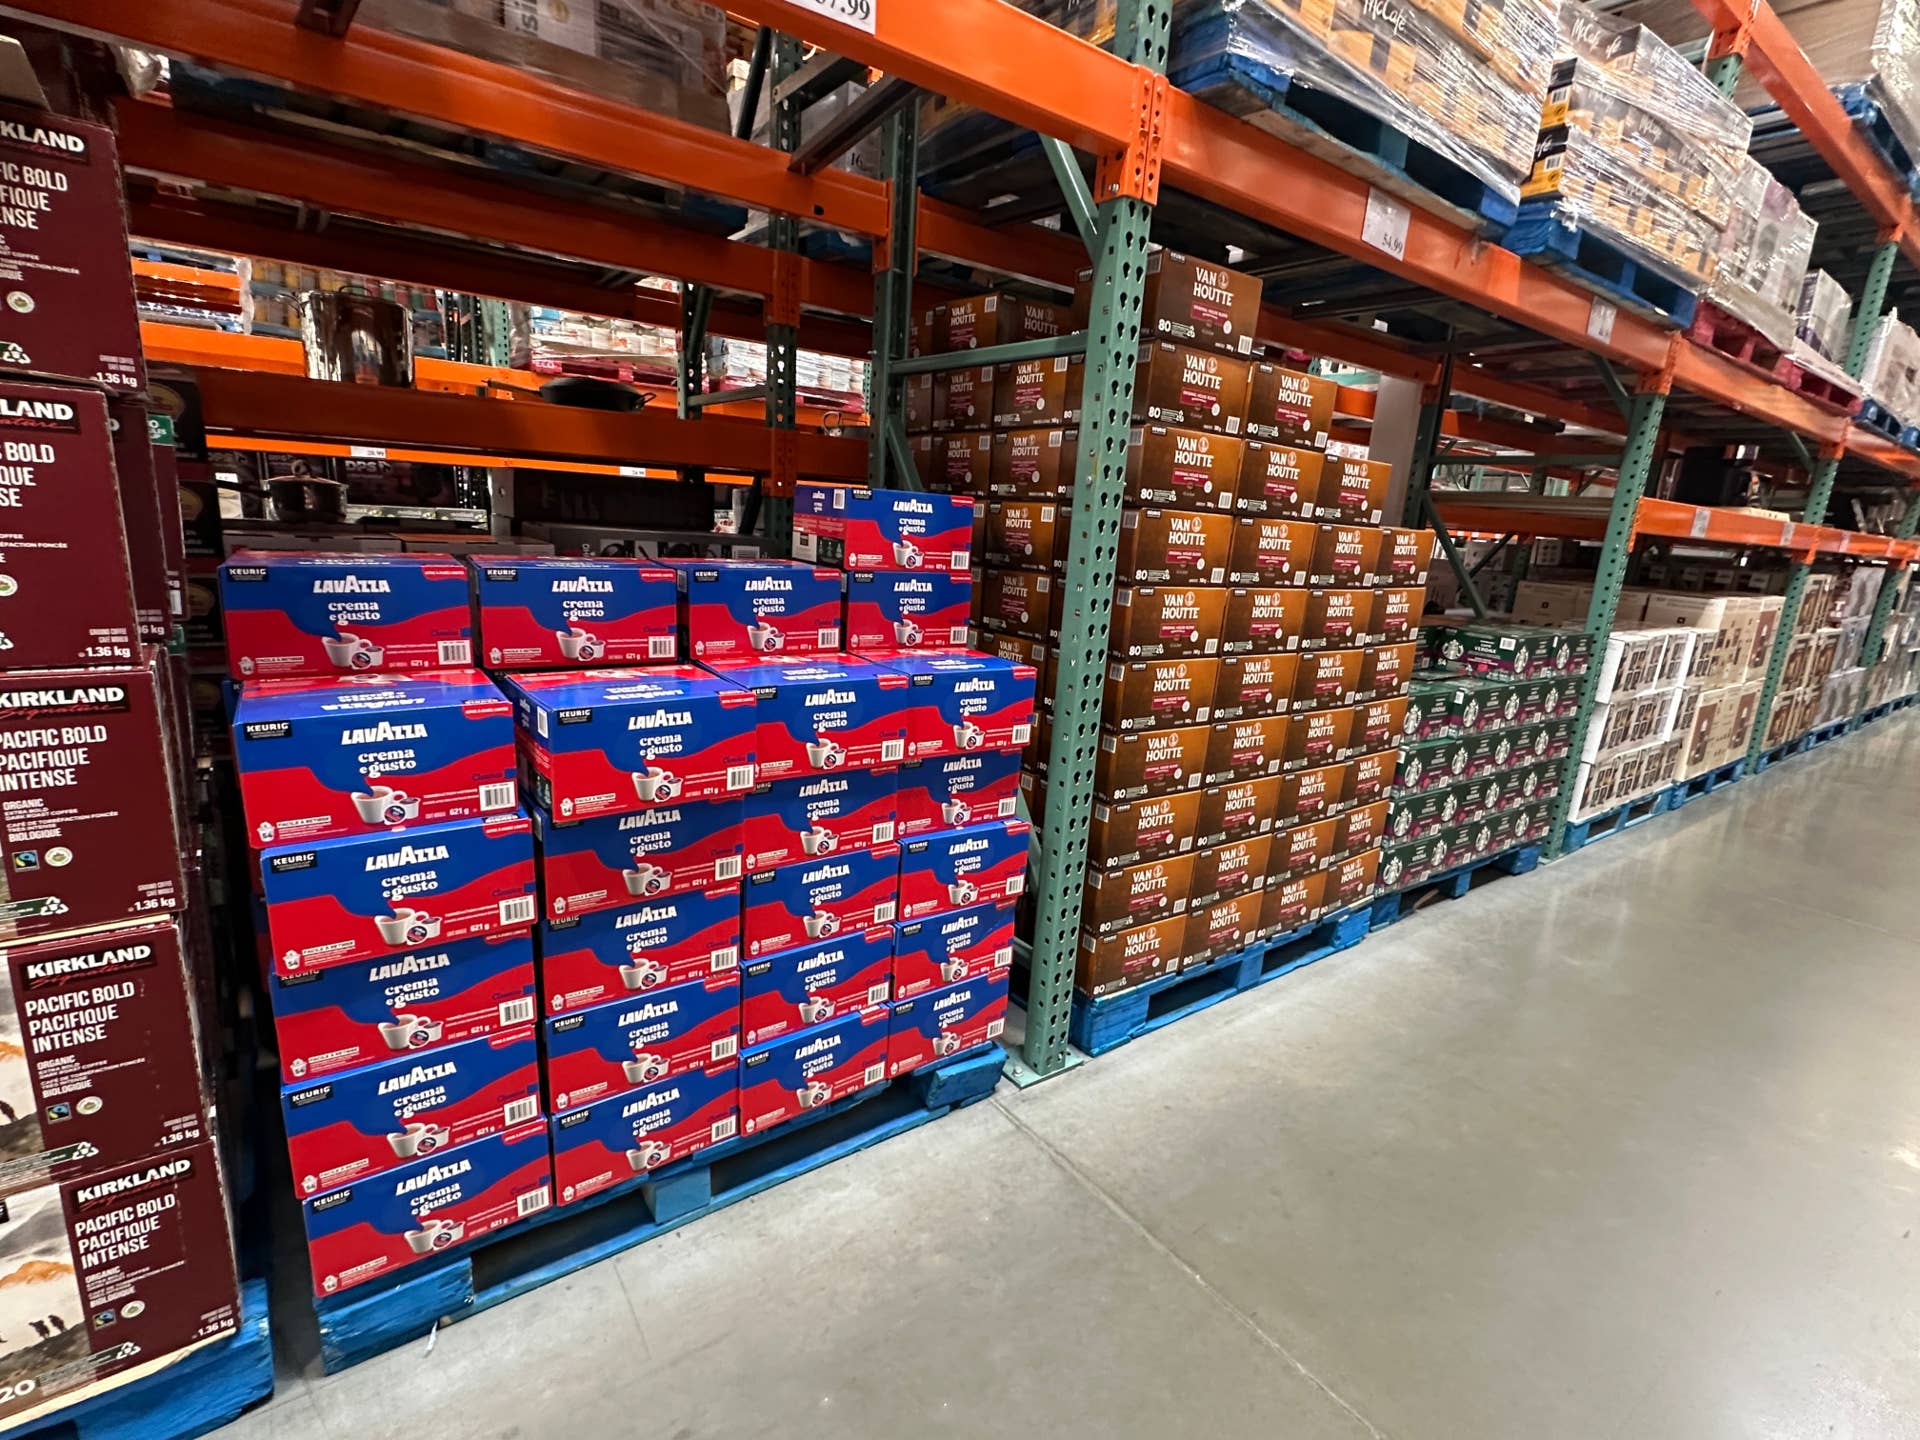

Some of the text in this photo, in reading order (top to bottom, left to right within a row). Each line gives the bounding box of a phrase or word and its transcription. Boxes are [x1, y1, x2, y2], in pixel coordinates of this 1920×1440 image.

[0, 161, 68, 191] IC BOLD
[0, 206, 39, 229] NSE
[1195, 267, 1217, 286] VAN
[1193, 282, 1234, 306] HOUTTE
[950, 313, 976, 326] HOUTTE
[951, 305, 966, 317] VAN
[1158, 319, 1171, 332] 80
[1017, 364, 1031, 375] VAN
[1185, 354, 1206, 371] VAN
[122, 374, 138, 387] kg
[1016, 372, 1045, 386] HOUTTE
[1182, 368, 1222, 390] HOUTTE
[1281, 375, 1300, 390] VAN
[1278, 389, 1313, 408] HOUTTE
[1, 399, 74, 421] LAND
[1149, 406, 1161, 418] 80
[1247, 423, 1259, 434] 80
[4, 441, 55, 463] BOLD
[1176, 436, 1198, 452] VAN
[1174, 450, 1214, 468] HOUTTE
[1140, 488, 1153, 500] 80
[893, 499, 933, 514] LAVAZZA
[899, 517, 926, 526] crema
[903, 524, 926, 535] gusto
[1170, 518, 1191, 532] VAN
[1168, 532, 1207, 546] HOUTTE
[229, 568, 266, 576] KEURIG
[1135, 569, 1148, 580] 80
[313, 575, 391, 593] LAVAZZA
[552, 576, 614, 592] LAVAZZA
[745, 576, 793, 591] LAVAZZA
[893, 578, 932, 592] LAVAZZA
[328, 602, 379, 611] crema
[563, 600, 604, 608] crema
[753, 597, 785, 605] crema
[1164, 593, 1184, 607] VAN
[338, 611, 381, 625] gusto
[570, 608, 604, 621] gusto
[758, 603, 785, 616] gusto
[1161, 606, 1200, 620] HOUTTE
[85, 646, 131, 658] 1.36 kg
[1155, 666, 1177, 679] VAN
[954, 677, 995, 693] LAVAZZA
[1153, 678, 1192, 692] HOUTTE
[0, 687, 124, 708] KIRKLAND
[804, 688, 857, 706] LAVAZZA
[960, 697, 987, 706] crema
[559, 709, 591, 718] KEURIG
[813, 710, 848, 720] crema
[963, 704, 987, 715] gusto
[246, 722, 289, 733] KEURIG
[628, 709, 693, 730] LAVAZZA
[818, 718, 848, 732] gusto
[61, 725, 108, 745] BOLD
[341, 721, 428, 745] LAVAZZA
[639, 733, 682, 747] crema
[0, 748, 90, 771] PACIFIQUE
[358, 748, 415, 764] crema
[646, 744, 683, 760] gusto
[369, 759, 417, 779] gusto
[943, 757, 982, 773] LAVAZZA
[0, 768, 78, 792] INTENSE
[799, 779, 849, 797] LAVAZZA
[2, 798, 44, 811] ORGANIC
[618, 808, 681, 831] LAVAZZA
[8, 828, 62, 842] BIOLOGIQUE
[629, 831, 671, 846] crema
[636, 839, 672, 857] gusto
[949, 838, 989, 855] LAVAZZA
[273, 853, 314, 866] KEURIG
[365, 845, 450, 872] LAVAZZA
[381, 870, 437, 888] crema
[802, 865, 850, 884] LAVAZZA
[392, 880, 439, 901] gusto
[134, 896, 176, 912] 1.36 kg
[615, 905, 677, 929] LAVAZZA
[942, 916, 978, 935] LAVAZZA
[626, 926, 667, 943] crema
[1126, 931, 1145, 945] VAN
[633, 935, 668, 953] gusto
[1124, 939, 1161, 958] HOUTTE
[27, 945, 152, 980] KIRKLAND
[369, 953, 450, 982] LAVAZZA
[797, 951, 844, 972] LAVAZZA
[384, 977, 438, 996] crema
[1093, 984, 1106, 995] 80
[24, 981, 135, 1017] PACIFIC BOLD
[394, 986, 440, 1009] gusto
[934, 991, 971, 1011] LAVAZZA
[28, 1003, 119, 1037] PACIFIQUE
[554, 1016, 584, 1028] KEURIG
[618, 1000, 679, 1027] LAVAZZA
[31, 1023, 107, 1054] INTENSE
[629, 1021, 669, 1039] crema
[635, 1029, 669, 1049] gusto
[795, 1035, 841, 1060] LAVAZZA
[37, 1054, 76, 1071] ORGANIC
[377, 1061, 457, 1095] LAVAZZA
[42, 1079, 93, 1099] BIOLOGIQUE
[292, 1086, 331, 1102] KEURIG
[393, 1085, 445, 1107] crema
[402, 1094, 447, 1119] gusto
[622, 1088, 680, 1118] LAVAZZA
[561, 1111, 589, 1125] KEURIG
[632, 1109, 671, 1128] crema
[638, 1116, 672, 1137] gusto
[160, 1127, 200, 1146] 1.36 kg
[76, 1159, 192, 1204] KIRKLAND
[395, 1159, 472, 1196] LAVAZZA
[314, 1190, 350, 1208] KEURIG
[410, 1183, 461, 1206] crema
[420, 1191, 462, 1217] gusto
[75, 1193, 176, 1238] PACIFIC BOLD
[78, 1214, 161, 1255] PACIFIQUE
[80, 1234, 149, 1270] INTENSE
[85, 1265, 120, 1284] ORGANIC
[198, 1318, 234, 1337] 1.36 kg
